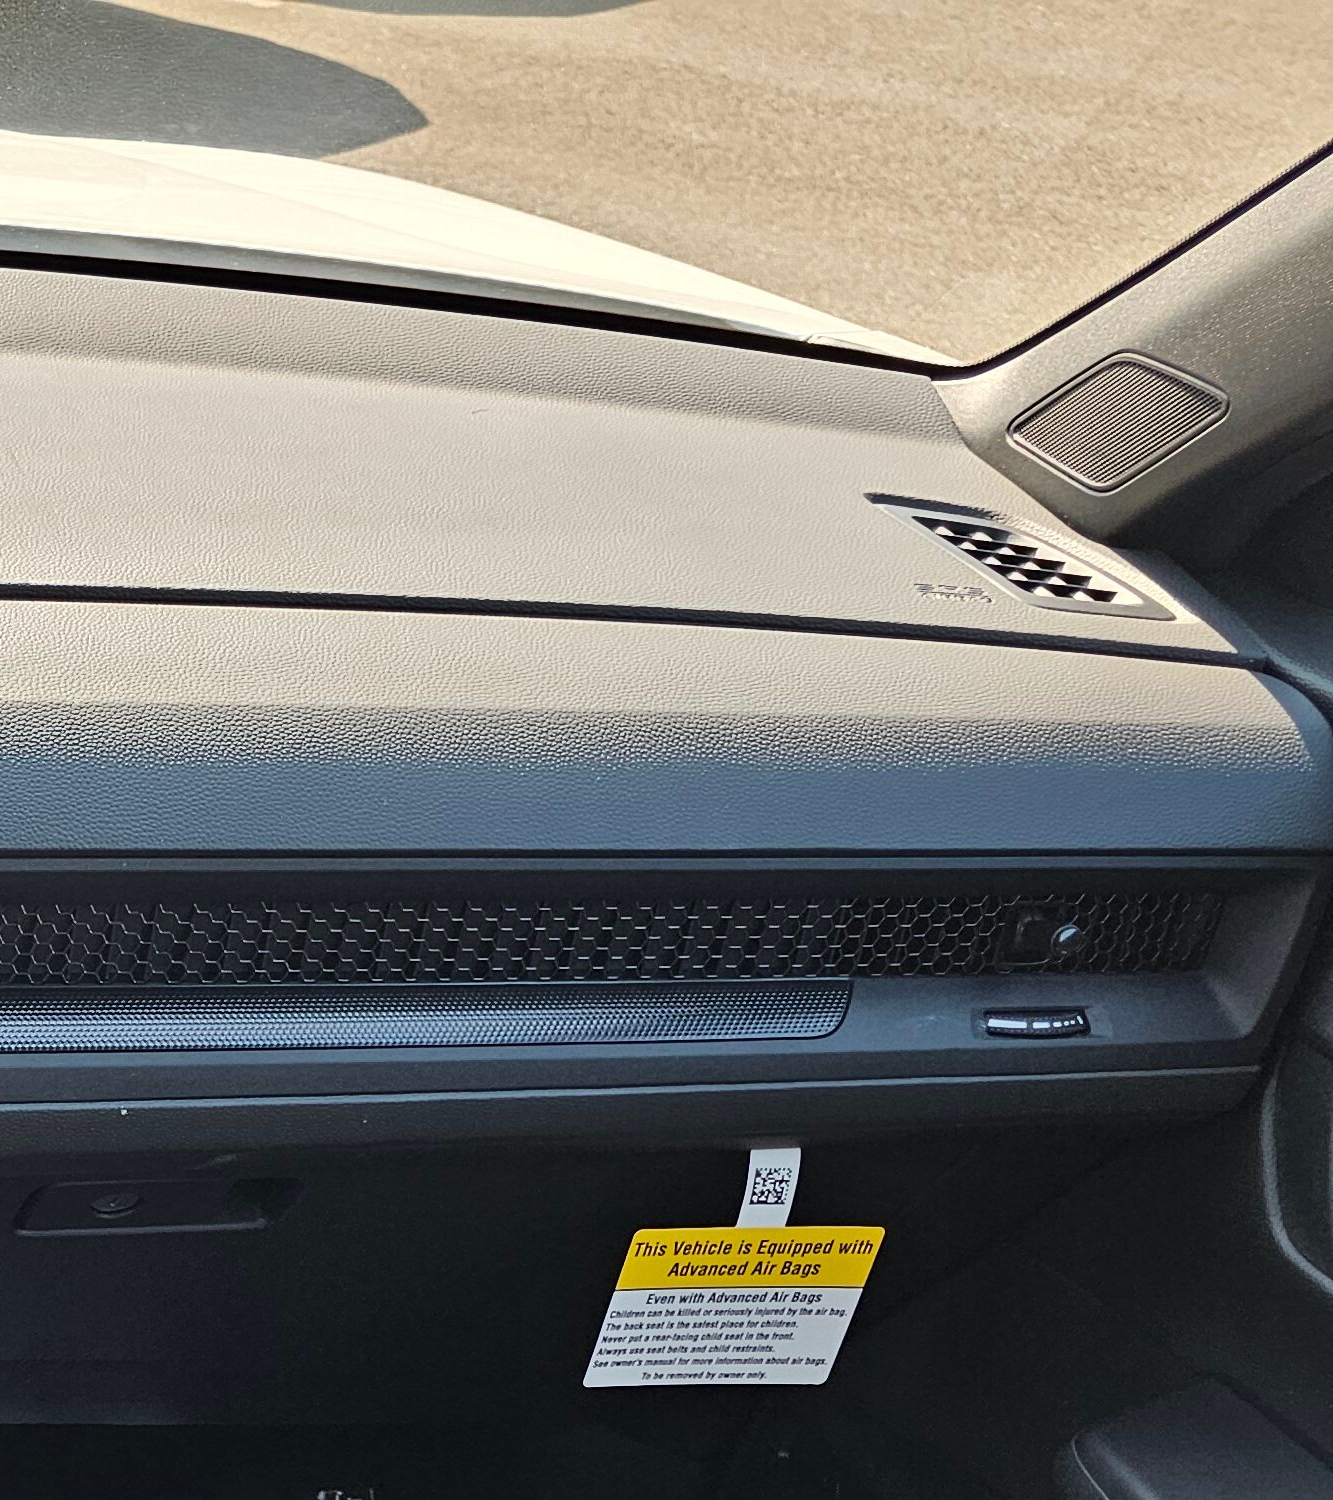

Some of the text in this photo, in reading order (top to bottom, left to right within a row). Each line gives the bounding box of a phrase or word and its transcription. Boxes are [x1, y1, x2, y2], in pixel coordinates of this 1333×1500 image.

[635, 1239, 874, 1258] This Vehicle is Equipped with
[667, 1260, 822, 1278] Advanced Air Bags
[645, 1291, 823, 1305] Even with Advanced Air Bags
[609, 1307, 848, 1319] Children can be killed or seriously injured by the air bag.
[605, 1320, 799, 1331] The back seat is the safest place for children.
[600, 1335, 627, 1344] Never
[628, 1335, 643, 1344] put
[651, 1333, 700, 1342] rear-facing
[700, 1333, 724, 1341] child
[724, 1332, 744, 1341] seat
[744, 1332, 754, 1340] in
[755, 1332, 770, 1340] the
[771, 1332, 795, 1341] front.
[596, 1347, 627, 1356] Always
[646, 1346, 666, 1354] seat
[666, 1345, 689, 1354] belts
[690, 1345, 707, 1353] and
[708, 1344, 731, 1353] child
[732, 1344, 775, 1353] restraints.
[593, 1360, 608, 1368] See
[610, 1358, 643, 1367] owner's
[677, 1357, 690, 1366] for
[691, 1358, 713, 1366] more
[714, 1357, 764, 1366] information
[764, 1356, 790, 1365] about
[791, 1356, 804, 1365] air
[804, 1356, 828, 1367] bags.
[642, 1371, 767, 1381] To be removed by owner only.
